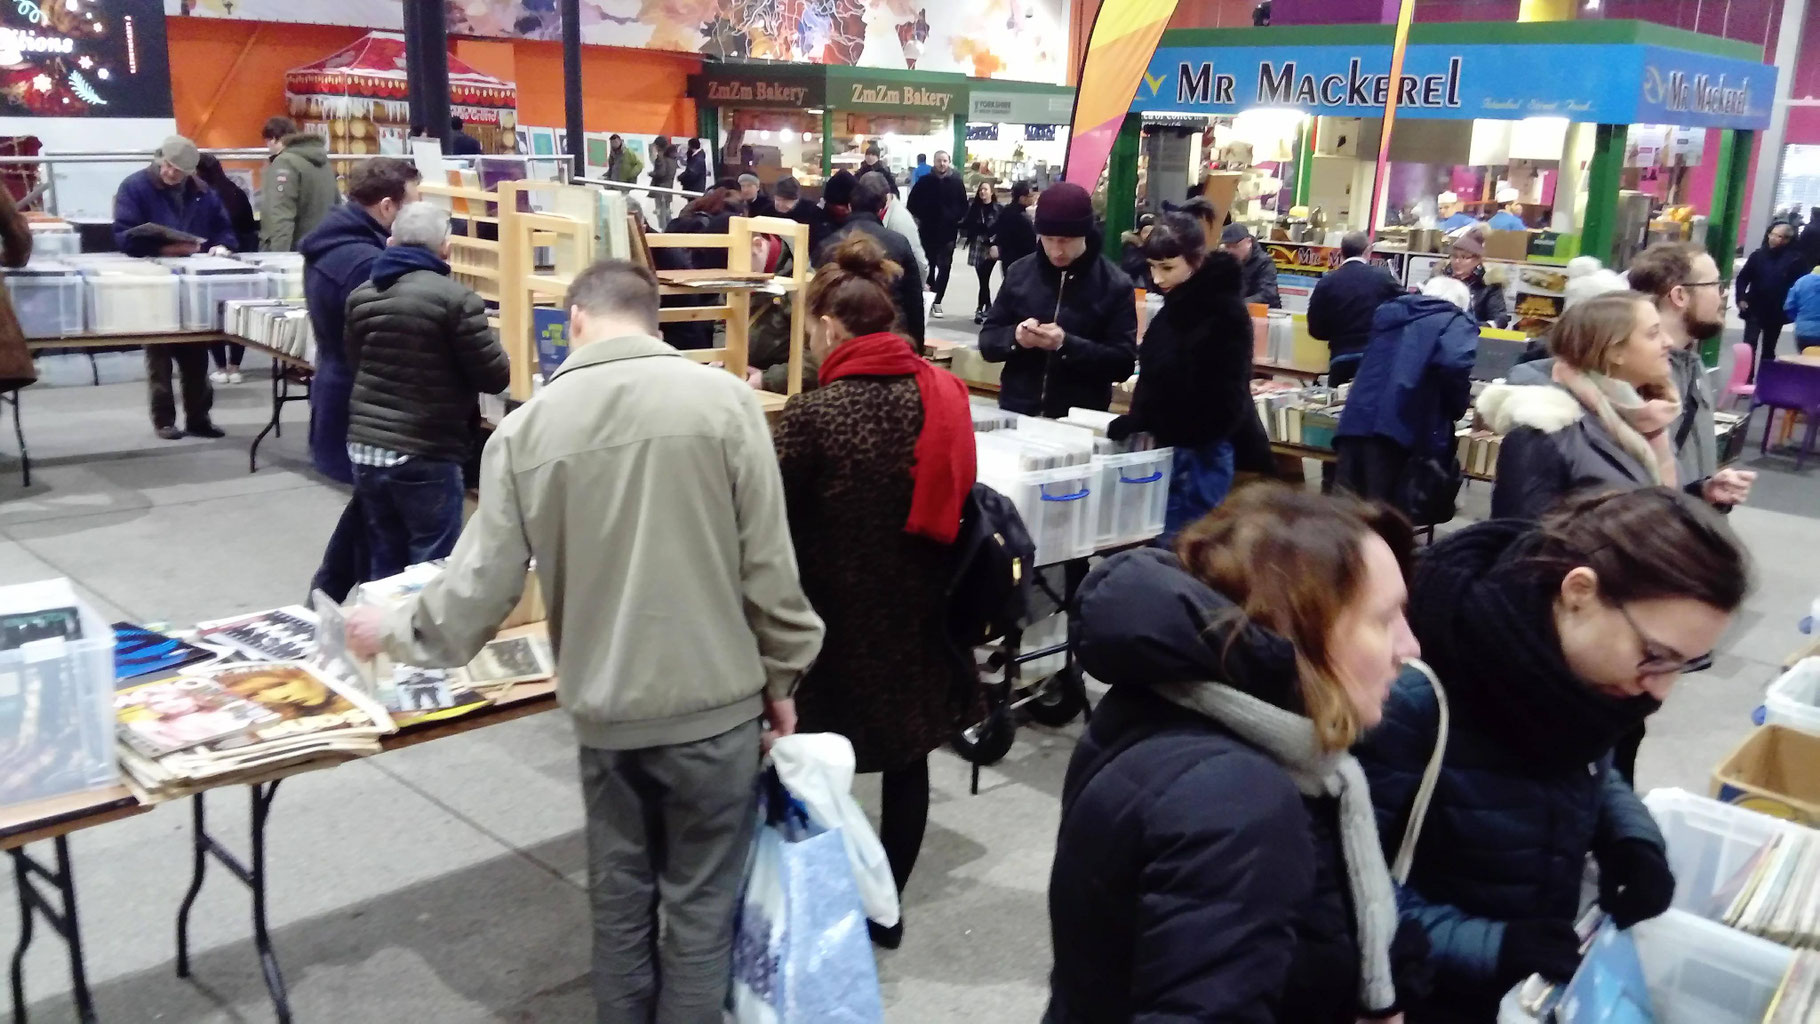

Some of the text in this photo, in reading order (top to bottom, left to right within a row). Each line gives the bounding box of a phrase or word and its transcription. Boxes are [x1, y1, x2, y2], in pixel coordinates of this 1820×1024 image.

[708, 81, 806, 106] ZmZm Bakery
[851, 83, 951, 111] ZmZm Bakery
